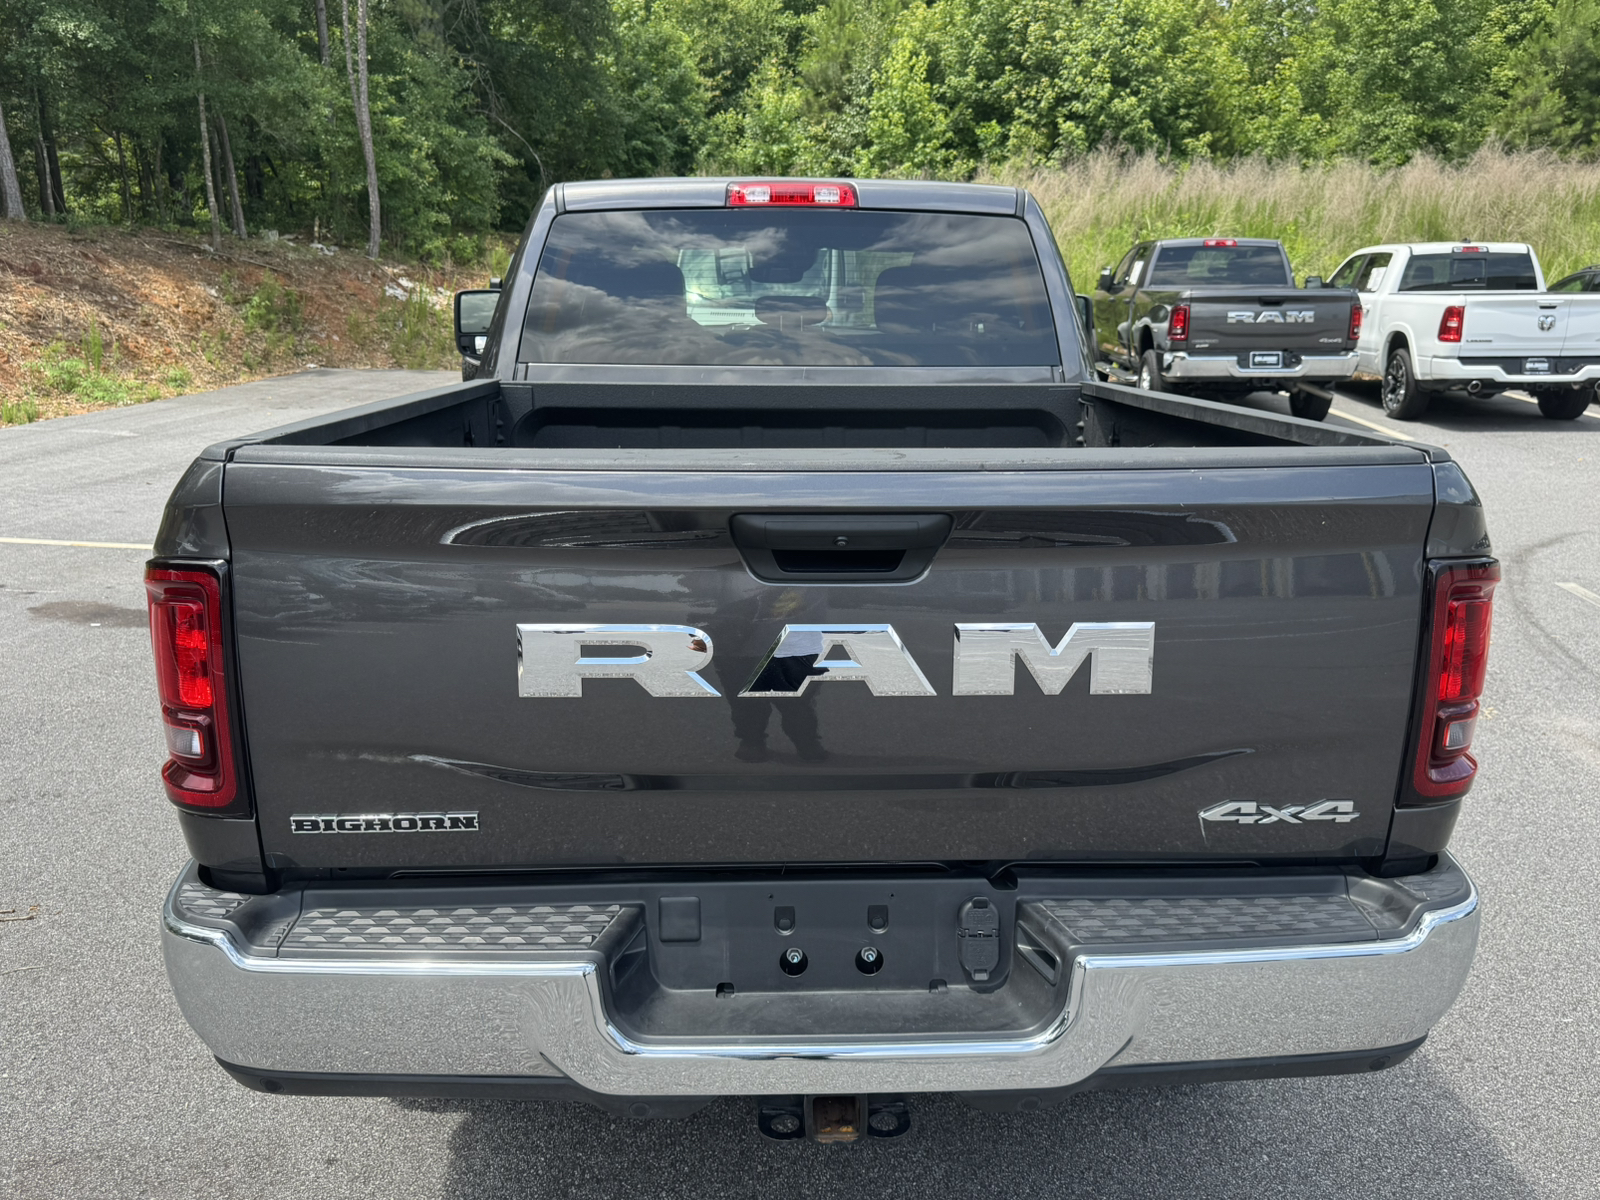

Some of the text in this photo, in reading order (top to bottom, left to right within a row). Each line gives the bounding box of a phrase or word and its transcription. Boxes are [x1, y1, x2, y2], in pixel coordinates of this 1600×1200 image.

[1227, 311, 1315, 324] RAM
[516, 621, 1156, 698] RAM
[290, 811, 480, 834] BIGHORN
[1198, 799, 1360, 825] 4x4
